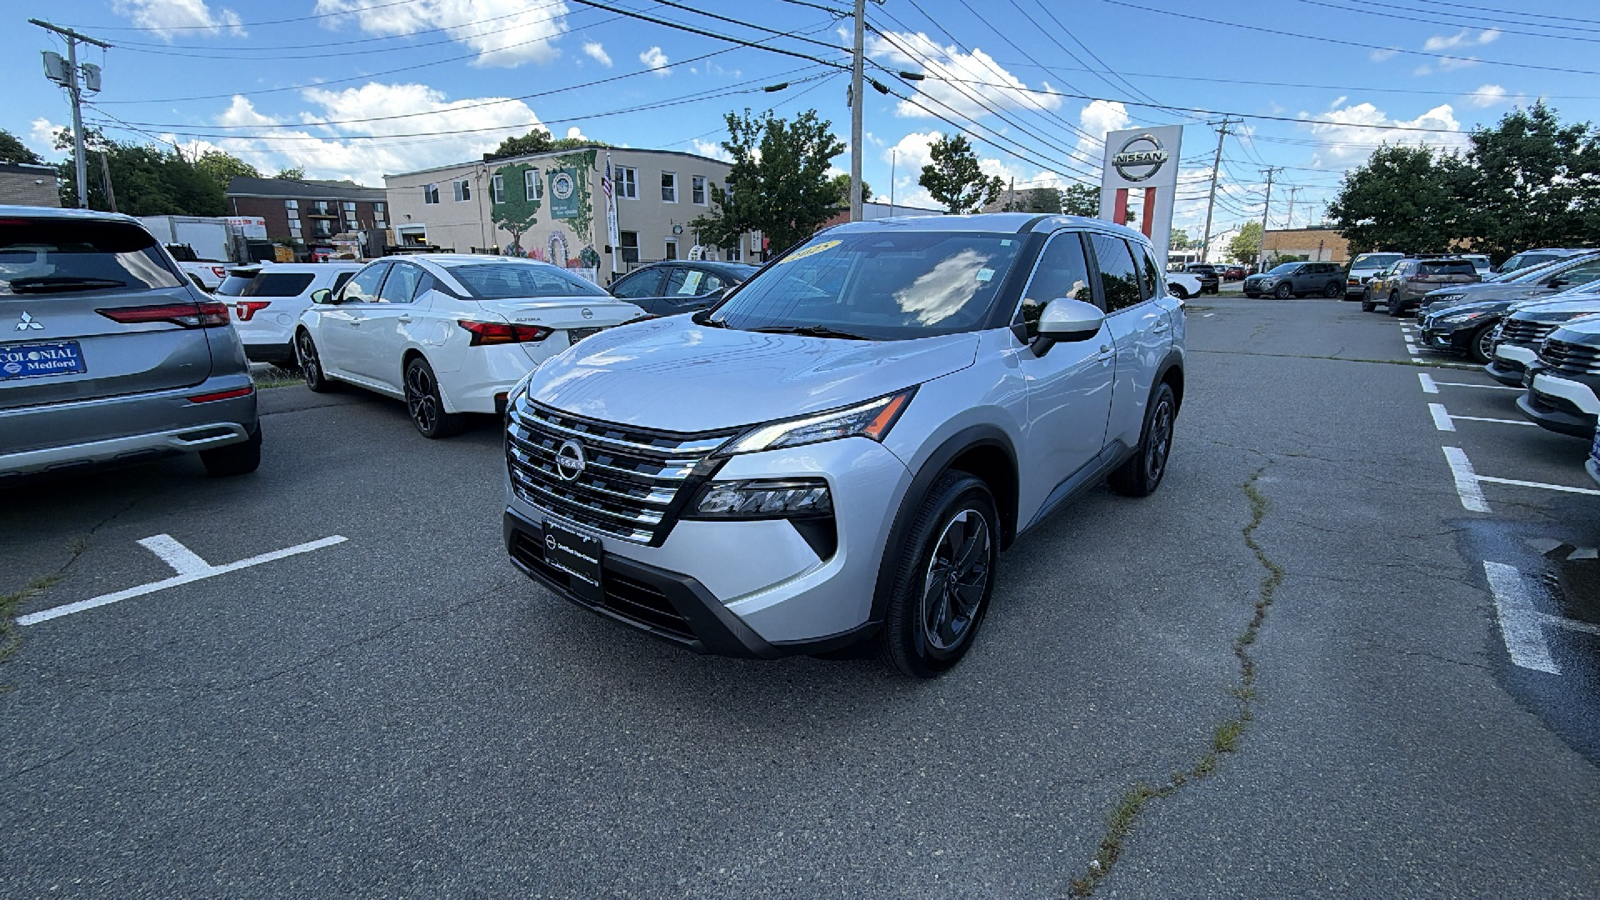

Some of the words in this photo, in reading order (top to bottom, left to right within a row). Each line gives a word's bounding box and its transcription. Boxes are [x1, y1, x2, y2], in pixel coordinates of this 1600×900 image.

[1116, 152, 1162, 163] NISSAN
[0, 349, 77, 363] COLONIAL
[27, 359, 76, 371] Medford
